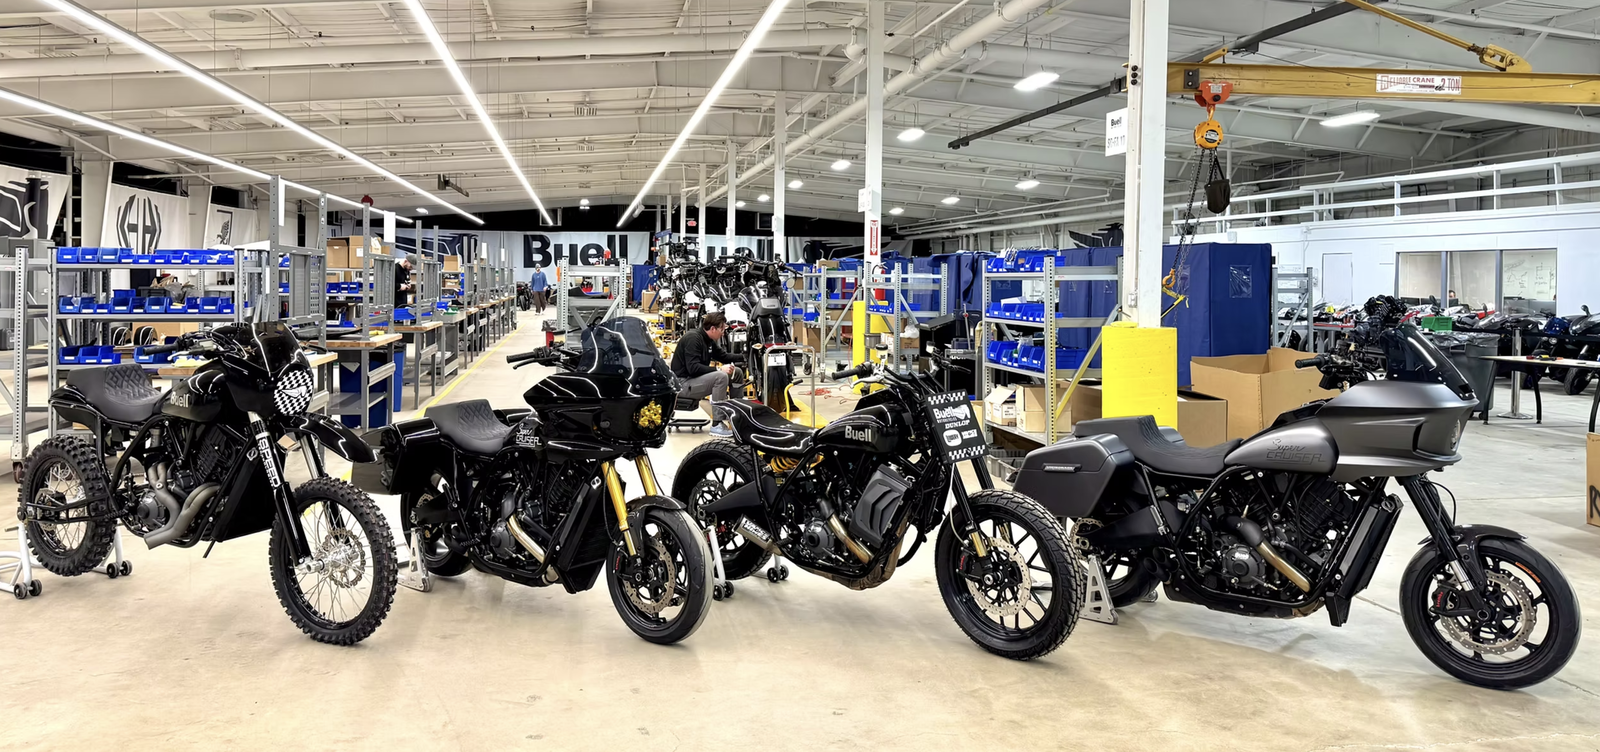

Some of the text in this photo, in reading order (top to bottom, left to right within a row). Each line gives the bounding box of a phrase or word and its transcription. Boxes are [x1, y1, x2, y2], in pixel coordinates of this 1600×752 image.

[1447, 78, 1460, 91] TON
[523, 234, 628, 268] Buell
[170, 391, 189, 408] Buell
[944, 419, 970, 429] DUNLOP
[845, 425, 872, 442] Buell
[1267, 438, 1306, 453] Super
[259, 438, 281, 488] SPEED
[1266, 451, 1326, 465] CRUISER
